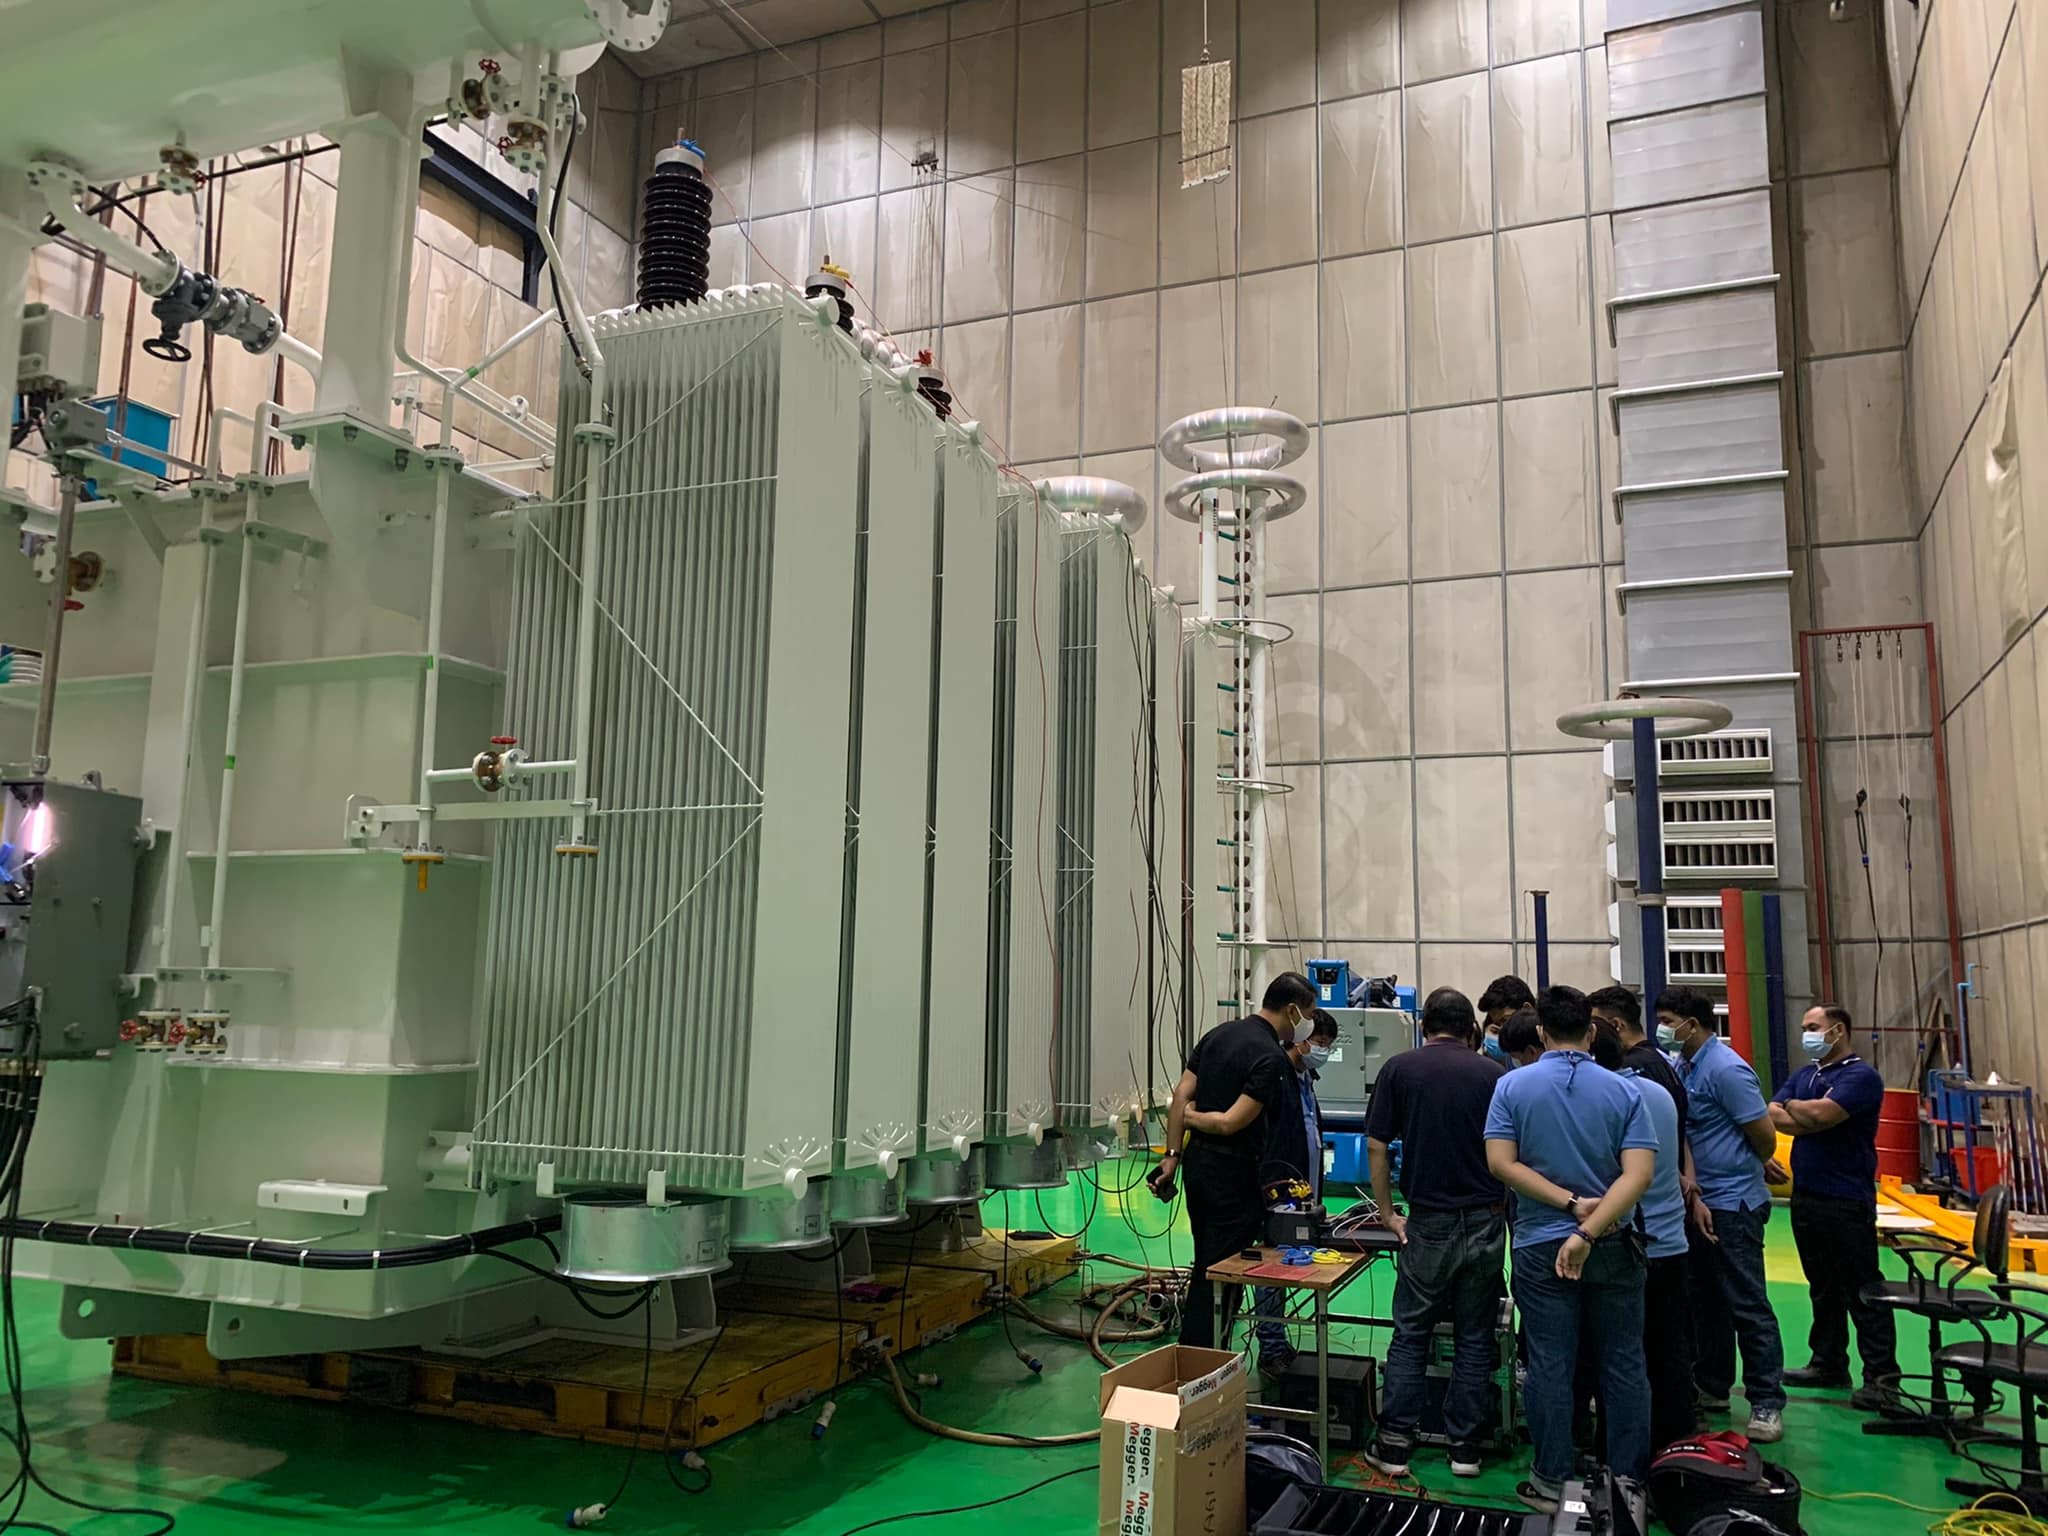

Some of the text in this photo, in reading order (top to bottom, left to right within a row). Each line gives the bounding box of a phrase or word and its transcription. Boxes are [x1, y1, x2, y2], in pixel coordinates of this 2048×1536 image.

[1121, 1422, 1140, 1536] Megger. Meg
[1140, 1424, 1153, 1478] egger.
